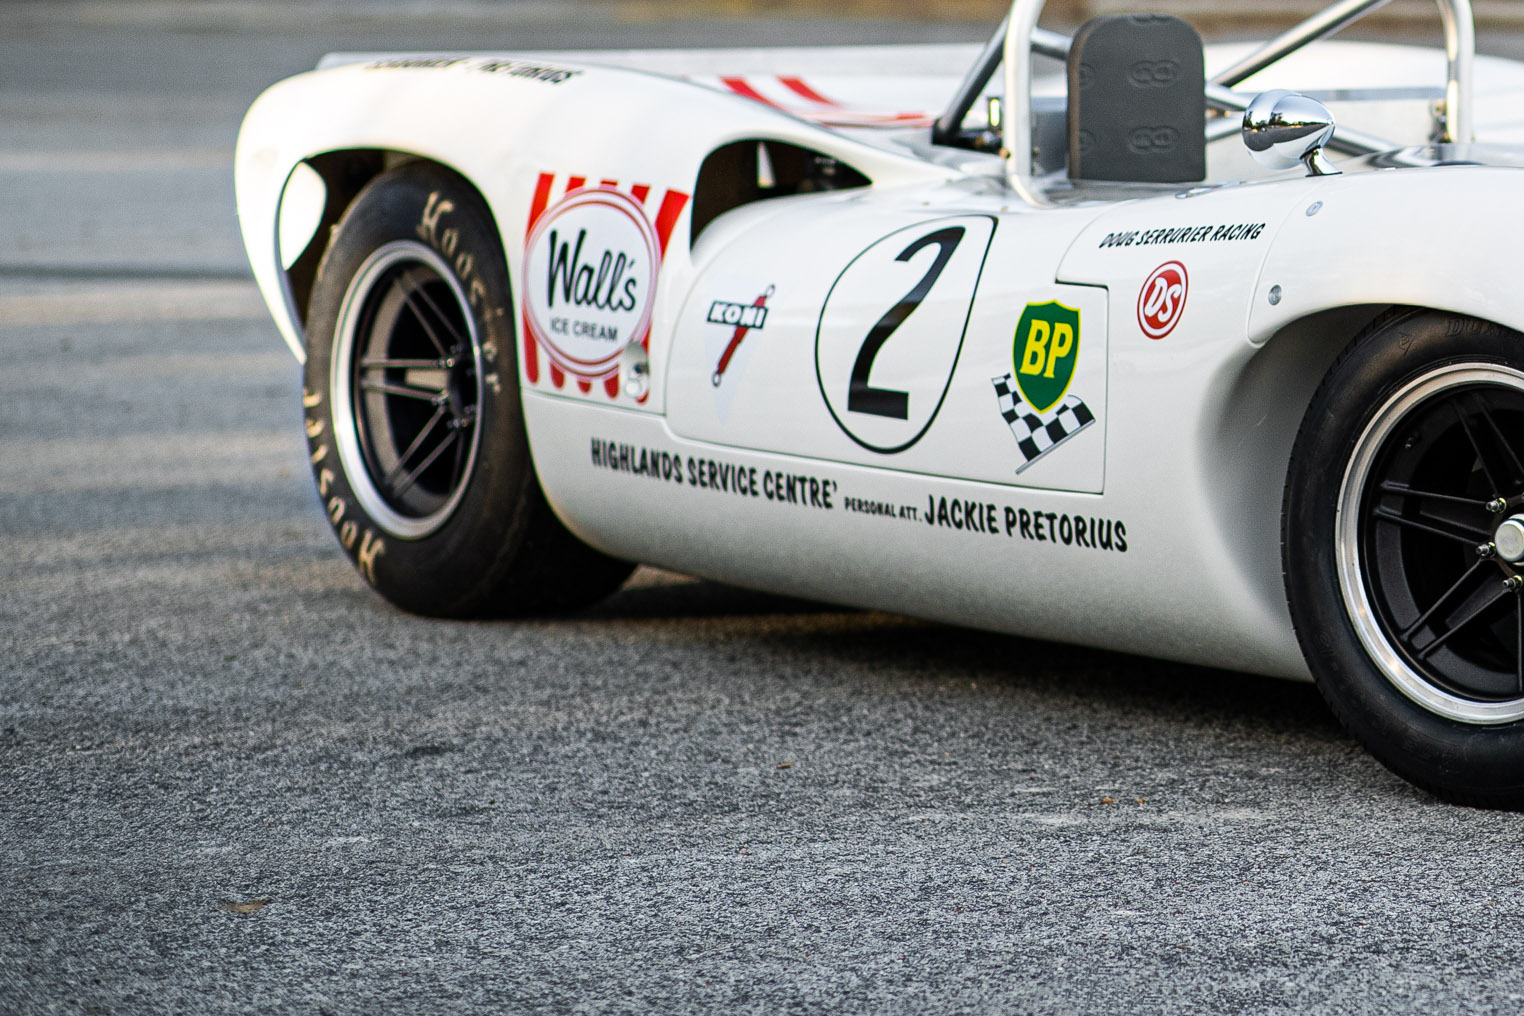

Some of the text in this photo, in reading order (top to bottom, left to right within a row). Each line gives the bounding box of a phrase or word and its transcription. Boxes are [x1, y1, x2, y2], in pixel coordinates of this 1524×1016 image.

[1098, 222, 1266, 249] DOUG SERRURIER RACING
[547, 228, 638, 312] Wall's
[709, 302, 766, 327] KONI
[847, 225, 967, 421] 2
[1143, 277, 1182, 323] DS
[551, 316, 619, 343] ICE CREAM
[1019, 319, 1074, 379] BP
[590, 437, 684, 484] HIGHLANDS
[688, 456, 760, 497] SERVICE
[844, 496, 897, 519] PERSONAL
[899, 505, 923, 522] ATT.
[924, 494, 1000, 534] JACKIE
[1003, 505, 1128, 553] PRETORIUS
